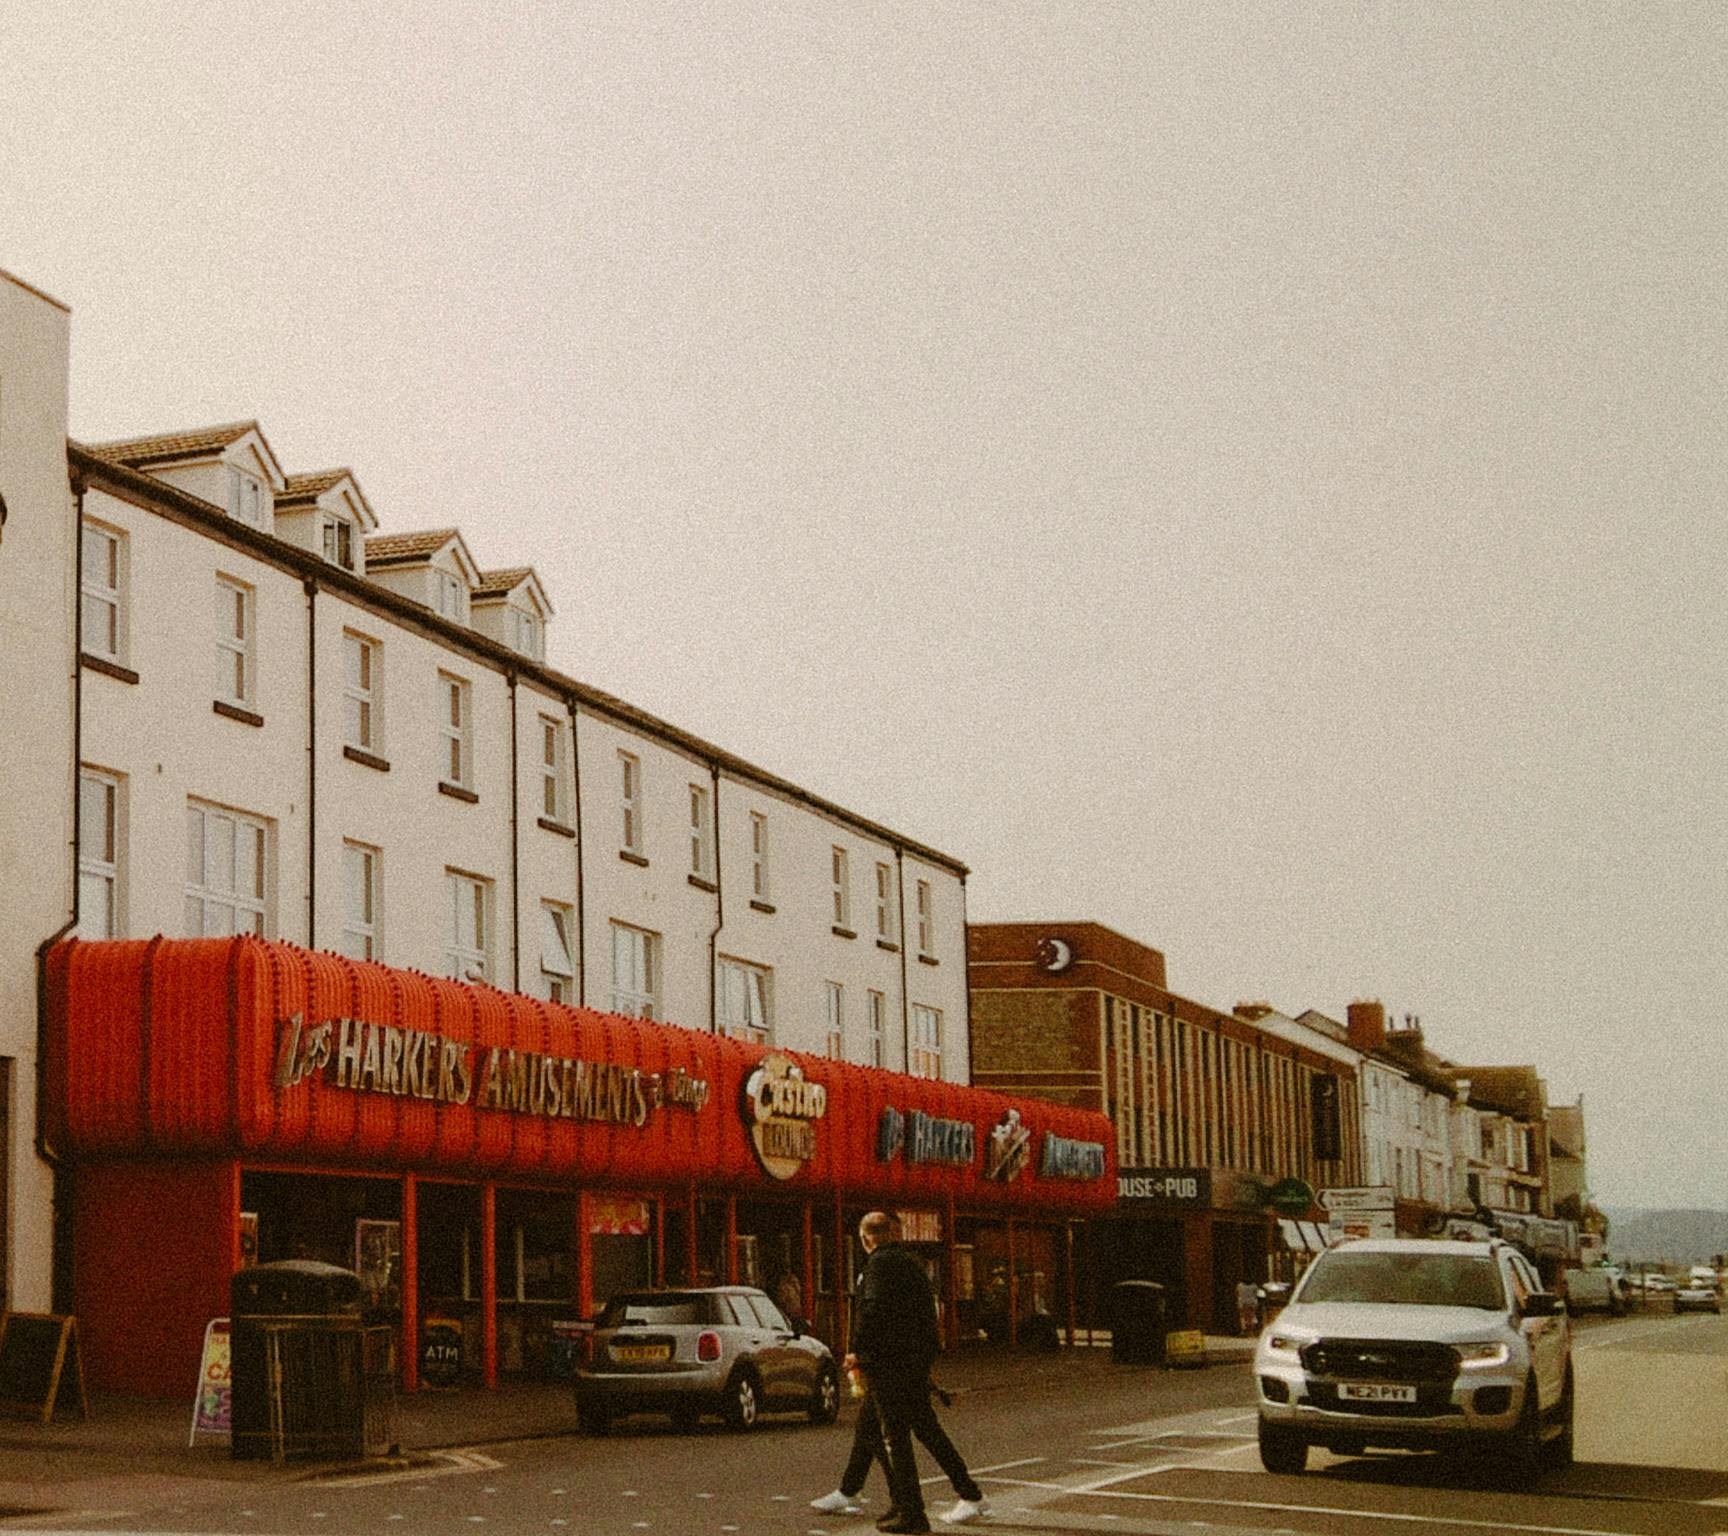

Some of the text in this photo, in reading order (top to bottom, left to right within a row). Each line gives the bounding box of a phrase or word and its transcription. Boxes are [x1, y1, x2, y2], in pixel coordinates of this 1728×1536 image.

[336, 1017, 472, 1105] HARKERS
[478, 1046, 647, 1127] AMUSEMENTS
[1166, 1177, 1198, 1198] PUB
[425, 1344, 459, 1361] ATM
